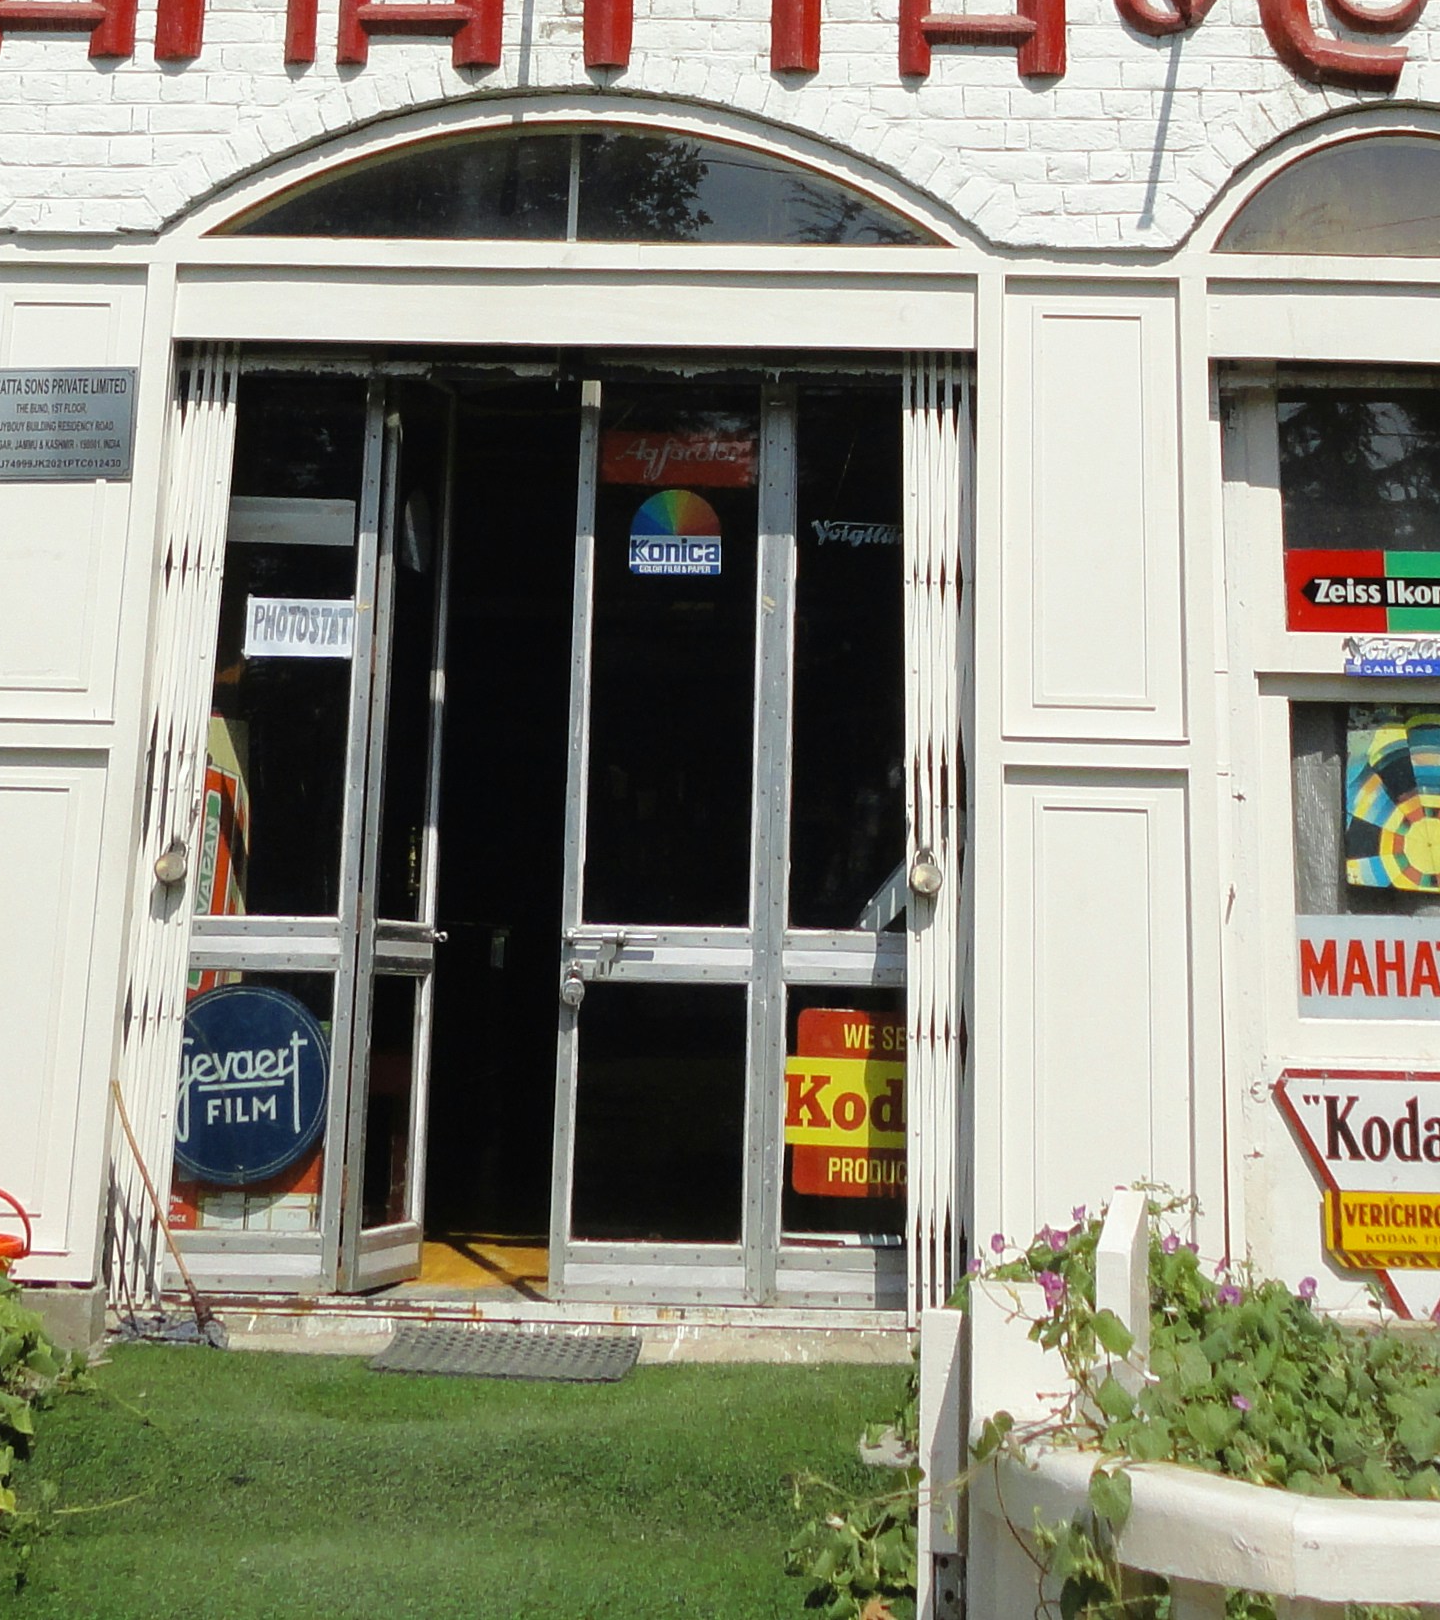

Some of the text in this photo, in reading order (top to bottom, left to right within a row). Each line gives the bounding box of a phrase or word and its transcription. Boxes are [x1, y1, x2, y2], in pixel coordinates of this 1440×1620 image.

[24, 378, 50, 395] SONS
[51, 378, 89, 394] PRIVATE
[91, 378, 127, 394] LIMITED
[16, 403, 29, 414] THE
[51, 403, 63, 414] 1ST
[631, 537, 720, 563] Konica
[1314, 578, 1381, 604] Zeiss
[253, 604, 354, 645] PHOTOSTAT
[1364, 665, 1433, 674] CAMERAS
[843, 1024, 907, 1051] WE SE
[175, 1030, 309, 1143] Gevaert
[207, 1094, 277, 1126] FILM
[784, 1073, 907, 1131] Kod
[827, 1157, 907, 1184] PRODUC
[1365, 1234, 1417, 1245] KODAK
